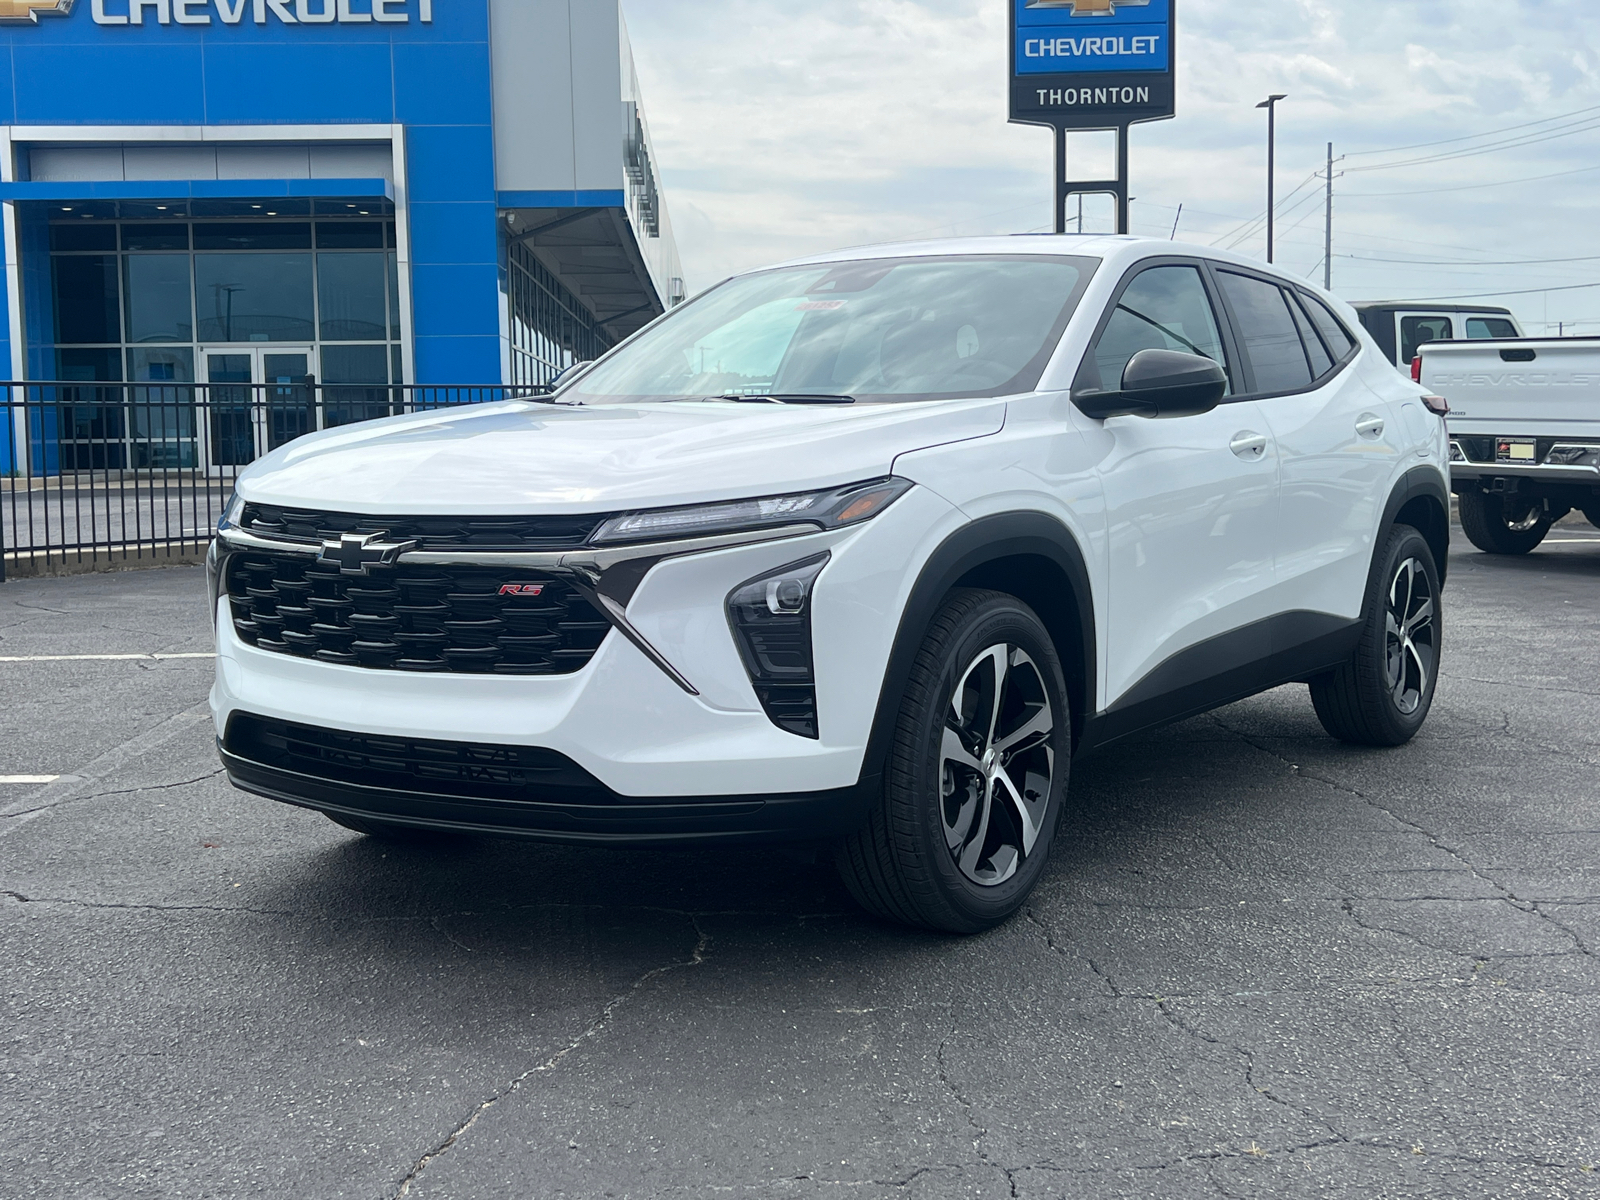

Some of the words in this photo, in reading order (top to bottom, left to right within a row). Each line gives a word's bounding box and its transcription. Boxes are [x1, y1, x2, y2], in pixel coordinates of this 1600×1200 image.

[1024, 35, 1160, 57] CHEVROLET
[1036, 86, 1149, 105] THORNTON
[498, 584, 544, 596] RS
